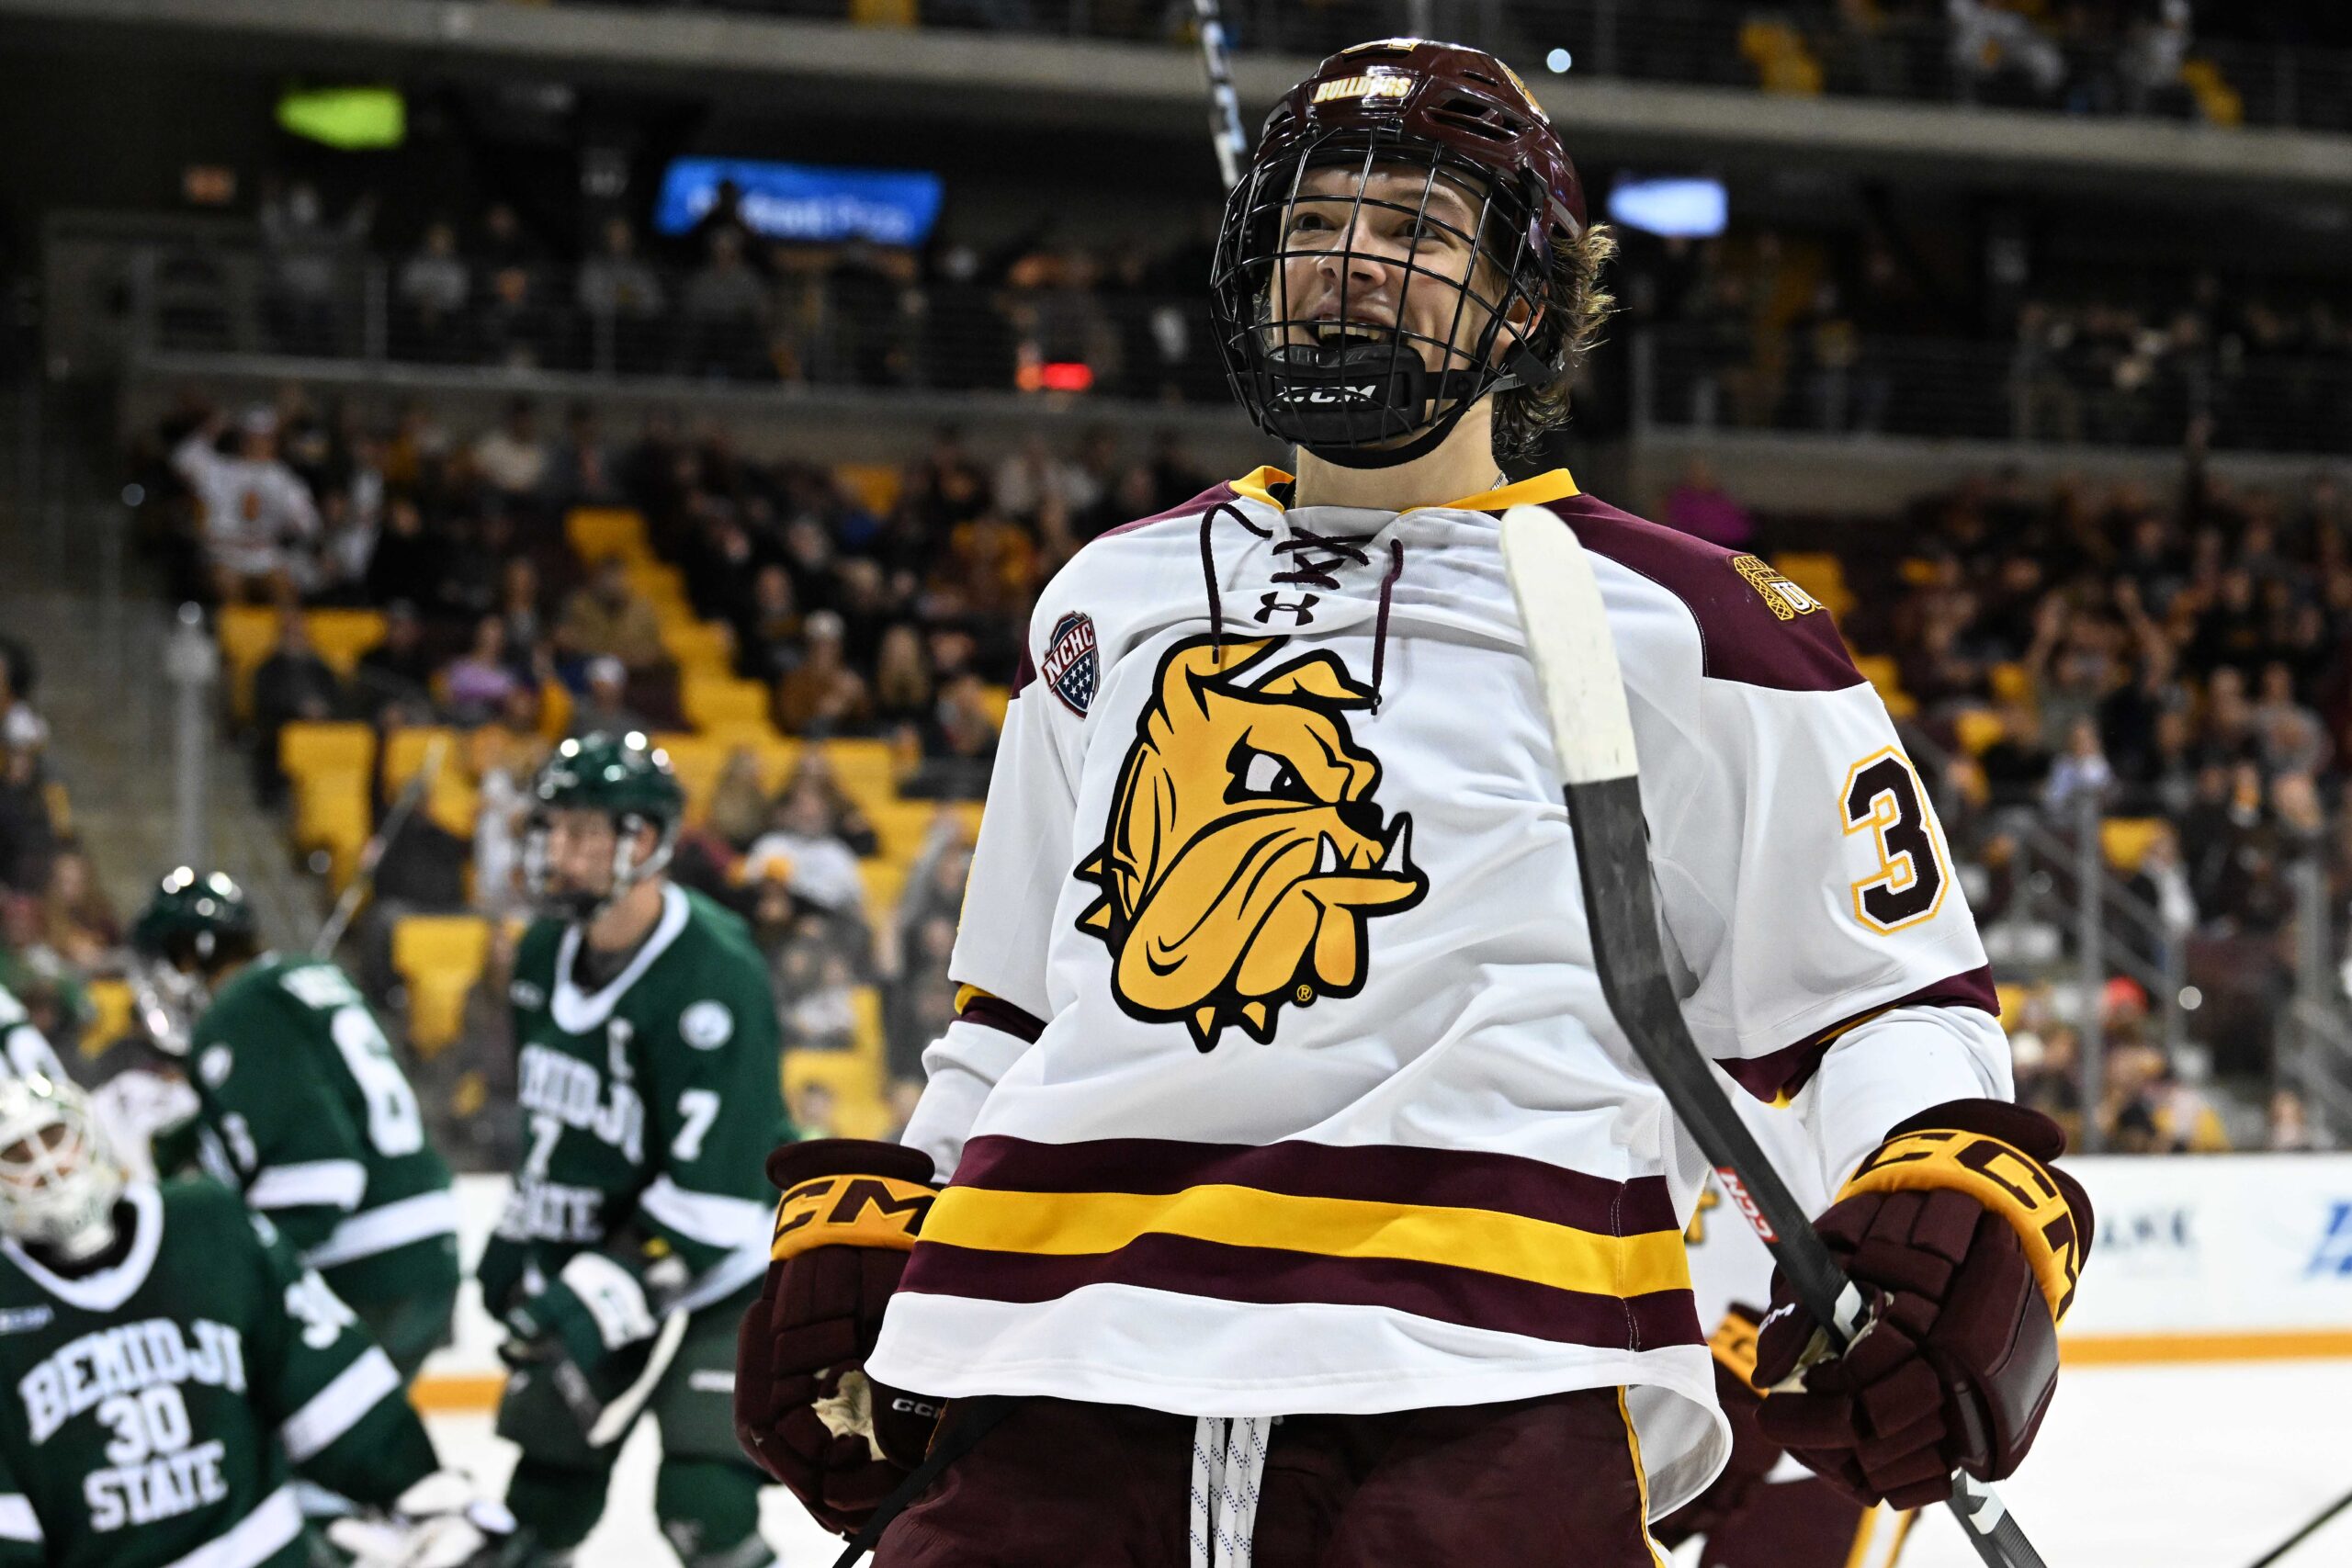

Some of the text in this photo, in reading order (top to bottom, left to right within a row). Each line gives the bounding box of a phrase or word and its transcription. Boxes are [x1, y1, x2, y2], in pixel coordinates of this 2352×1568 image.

[1045, 623, 1093, 685] NCHC
[1839, 745, 1950, 936] 3
[518, 1043, 645, 1165] MIDJI
[672, 1088, 720, 1161] 7
[1850, 1133, 2077, 1323] CCM
[17, 1317, 246, 1445] BEMIDJI
[96, 1382, 192, 1468] 30
[84, 1439, 228, 1533] STATE
